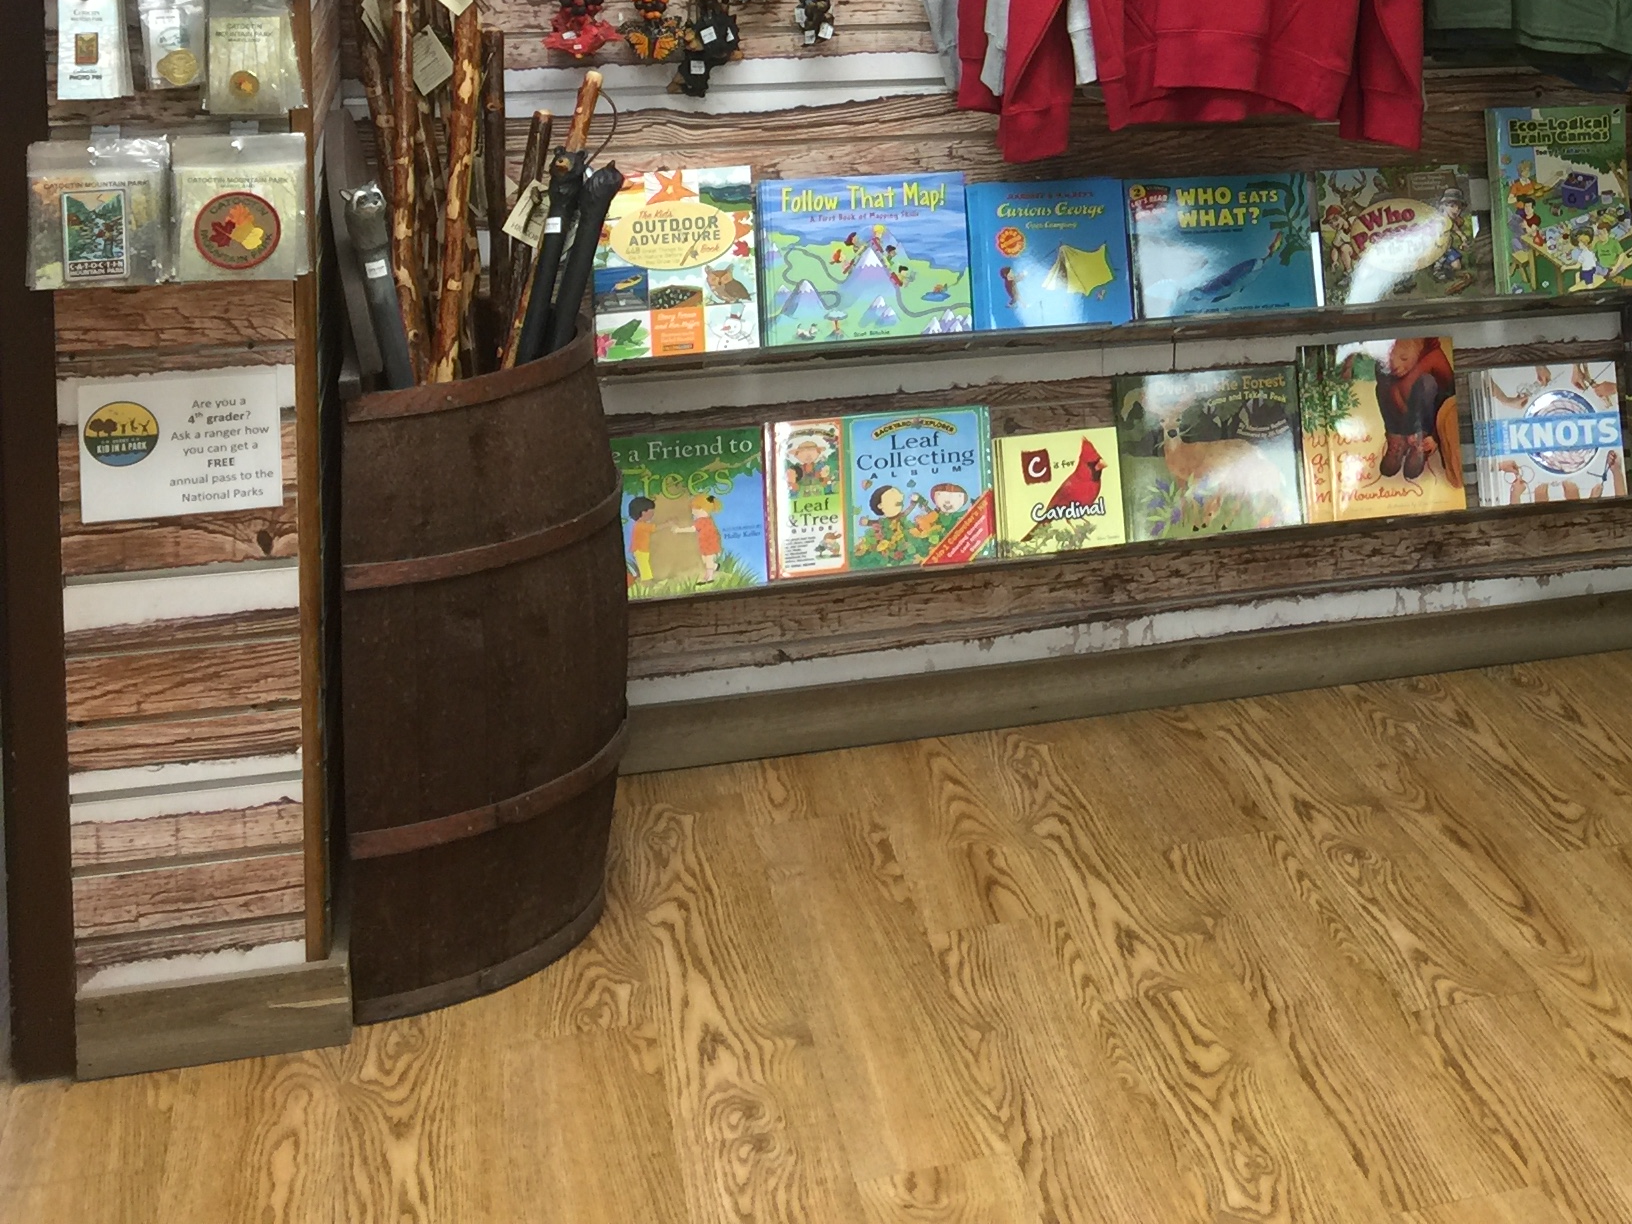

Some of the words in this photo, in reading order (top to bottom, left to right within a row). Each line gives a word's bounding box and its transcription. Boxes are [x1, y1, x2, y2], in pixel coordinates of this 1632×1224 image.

[1508, 115, 1610, 133] Eco-Logical
[1509, 131, 1554, 146] Brain
[1556, 129, 1610, 145] Games
[43, 181, 83, 190] CATOCTIN
[84, 180, 126, 189] MOUNTAIN
[127, 179, 148, 187] PARK
[1131, 186, 1143, 198] 2
[781, 185, 838, 213] Follow
[846, 184, 896, 210] That
[902, 181, 947, 212] Map!
[1176, 187, 1232, 207] WHO
[1238, 189, 1279, 204] EATS
[208, 197, 269, 217] CATOCTIN
[639, 209, 653, 219] The
[996, 202, 1053, 218] Curious
[1054, 201, 1105, 219] George
[632, 215, 719, 234] OUTDOOR
[818, 214, 836, 222] First
[838, 213, 856, 221] Book
[869, 211, 899, 220] Mapping
[1178, 206, 1260, 228] WHAT?
[1359, 205, 1416, 232] Who
[200, 228, 249, 263] MOUNTAIN
[250, 232, 274, 260] PARK
[629, 229, 721, 246] ADVENTURE
[700, 243, 721, 254] Book
[1155, 381, 1189, 396] Over
[1195, 381, 1209, 393] in
[1216, 378, 1239, 392] the
[1242, 374, 1286, 390] Forest
[191, 399, 212, 411] Are
[215, 398, 237, 411] you
[239, 397, 247, 406] a
[206, 410, 252, 426] grader?
[170, 429, 191, 442] Ask
[193, 430, 201, 440] a
[204, 427, 241, 441] ranger
[244, 424, 270, 436] how
[873, 420, 911, 437] BACKYARD
[1509, 417, 1620, 451] KNOTS
[96, 443, 110, 455] KID
[111, 443, 120, 453] IN
[128, 441, 147, 452] PARK
[182, 444, 204, 457] you
[207, 442, 228, 454] can
[230, 441, 249, 454] get
[251, 441, 259, 450] a
[628, 449, 640, 462] a
[647, 435, 723, 462] Friend
[729, 438, 753, 454] to
[891, 431, 940, 451] Leaf
[207, 456, 235, 469] FREE
[856, 449, 975, 471] Collecting
[1028, 456, 1047, 478] C
[1053, 461, 1059, 469] is
[1060, 459, 1076, 469] for
[1337, 451, 1377, 469] Going
[169, 473, 209, 487] annual
[211, 472, 237, 486] pass
[239, 470, 253, 481] to
[254, 467, 274, 480] the
[870, 466, 962, 480] ALBUM
[181, 489, 231, 504] National
[233, 486, 264, 500] Parks
[1340, 487, 1409, 505] Mountains
[793, 497, 829, 514] Leaf
[1031, 496, 1106, 523] Cardinal
[786, 515, 799, 528] &
[799, 512, 839, 526] Tree
[791, 525, 833, 534] GUIDE
